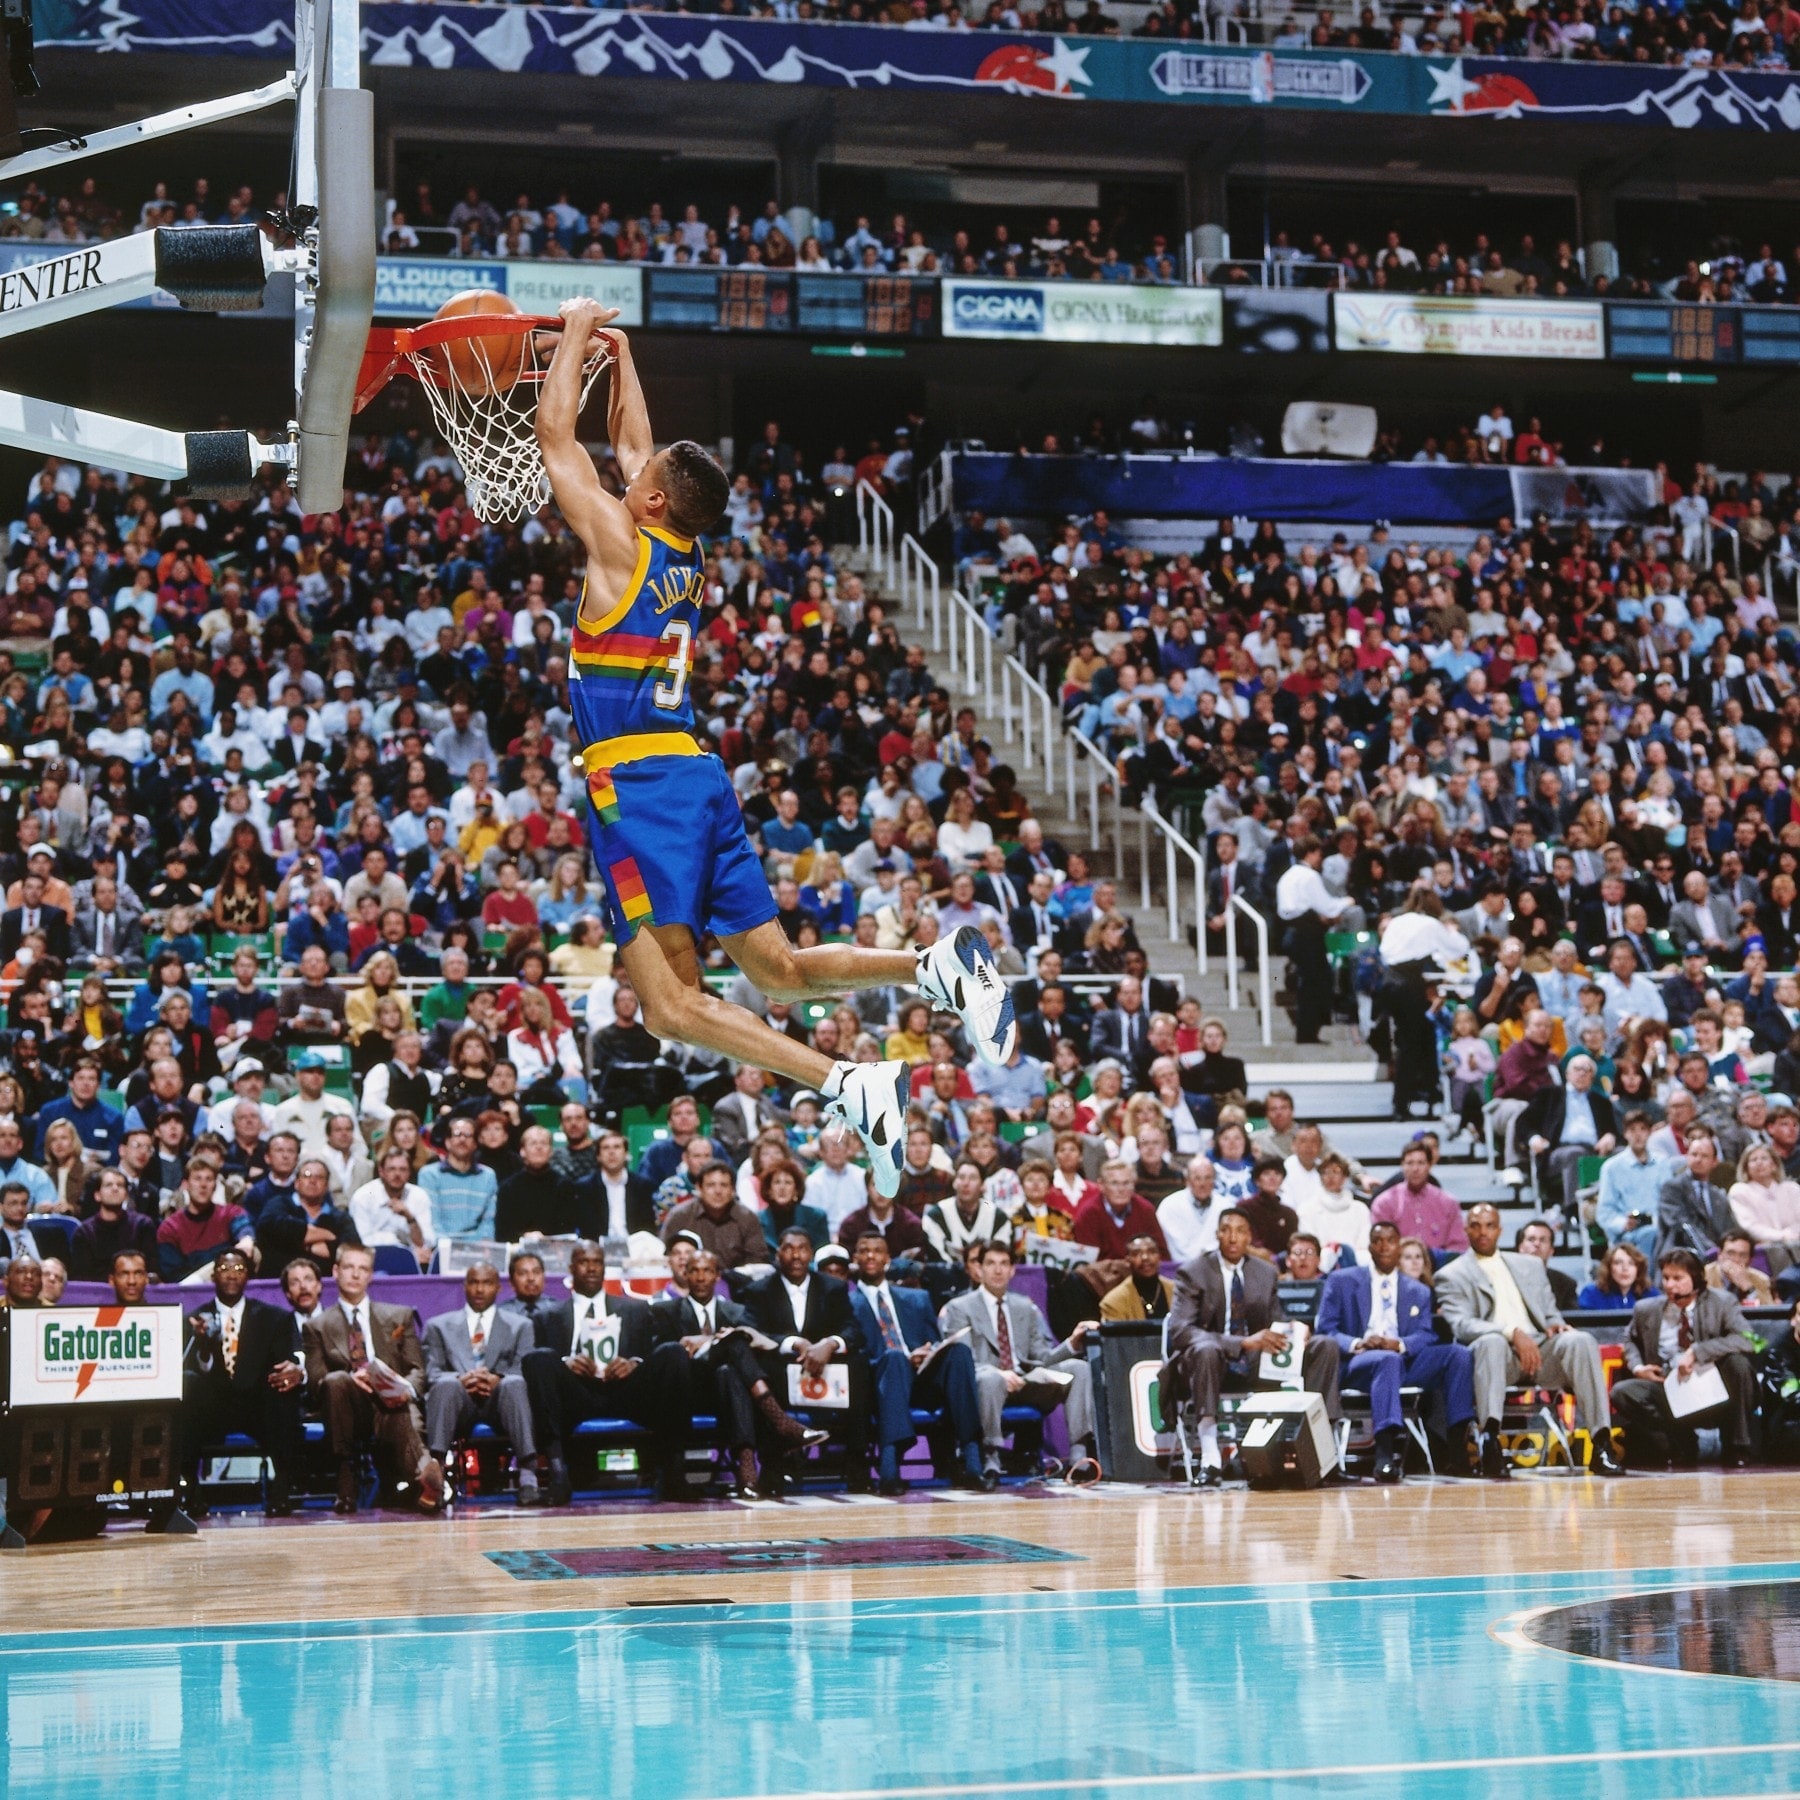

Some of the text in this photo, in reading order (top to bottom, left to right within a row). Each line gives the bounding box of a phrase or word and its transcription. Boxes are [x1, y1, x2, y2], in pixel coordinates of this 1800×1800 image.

[0, 249, 105, 312] ENTER
[955, 294, 1041, 321] CIGNA
[653, 619, 692, 710] 3
[977, 964, 995, 991] NIKE
[44, 1321, 152, 1362] Gatorade
[583, 1335, 615, 1363] 10
[44, 1363, 152, 1373] THIRST QUENCHER
